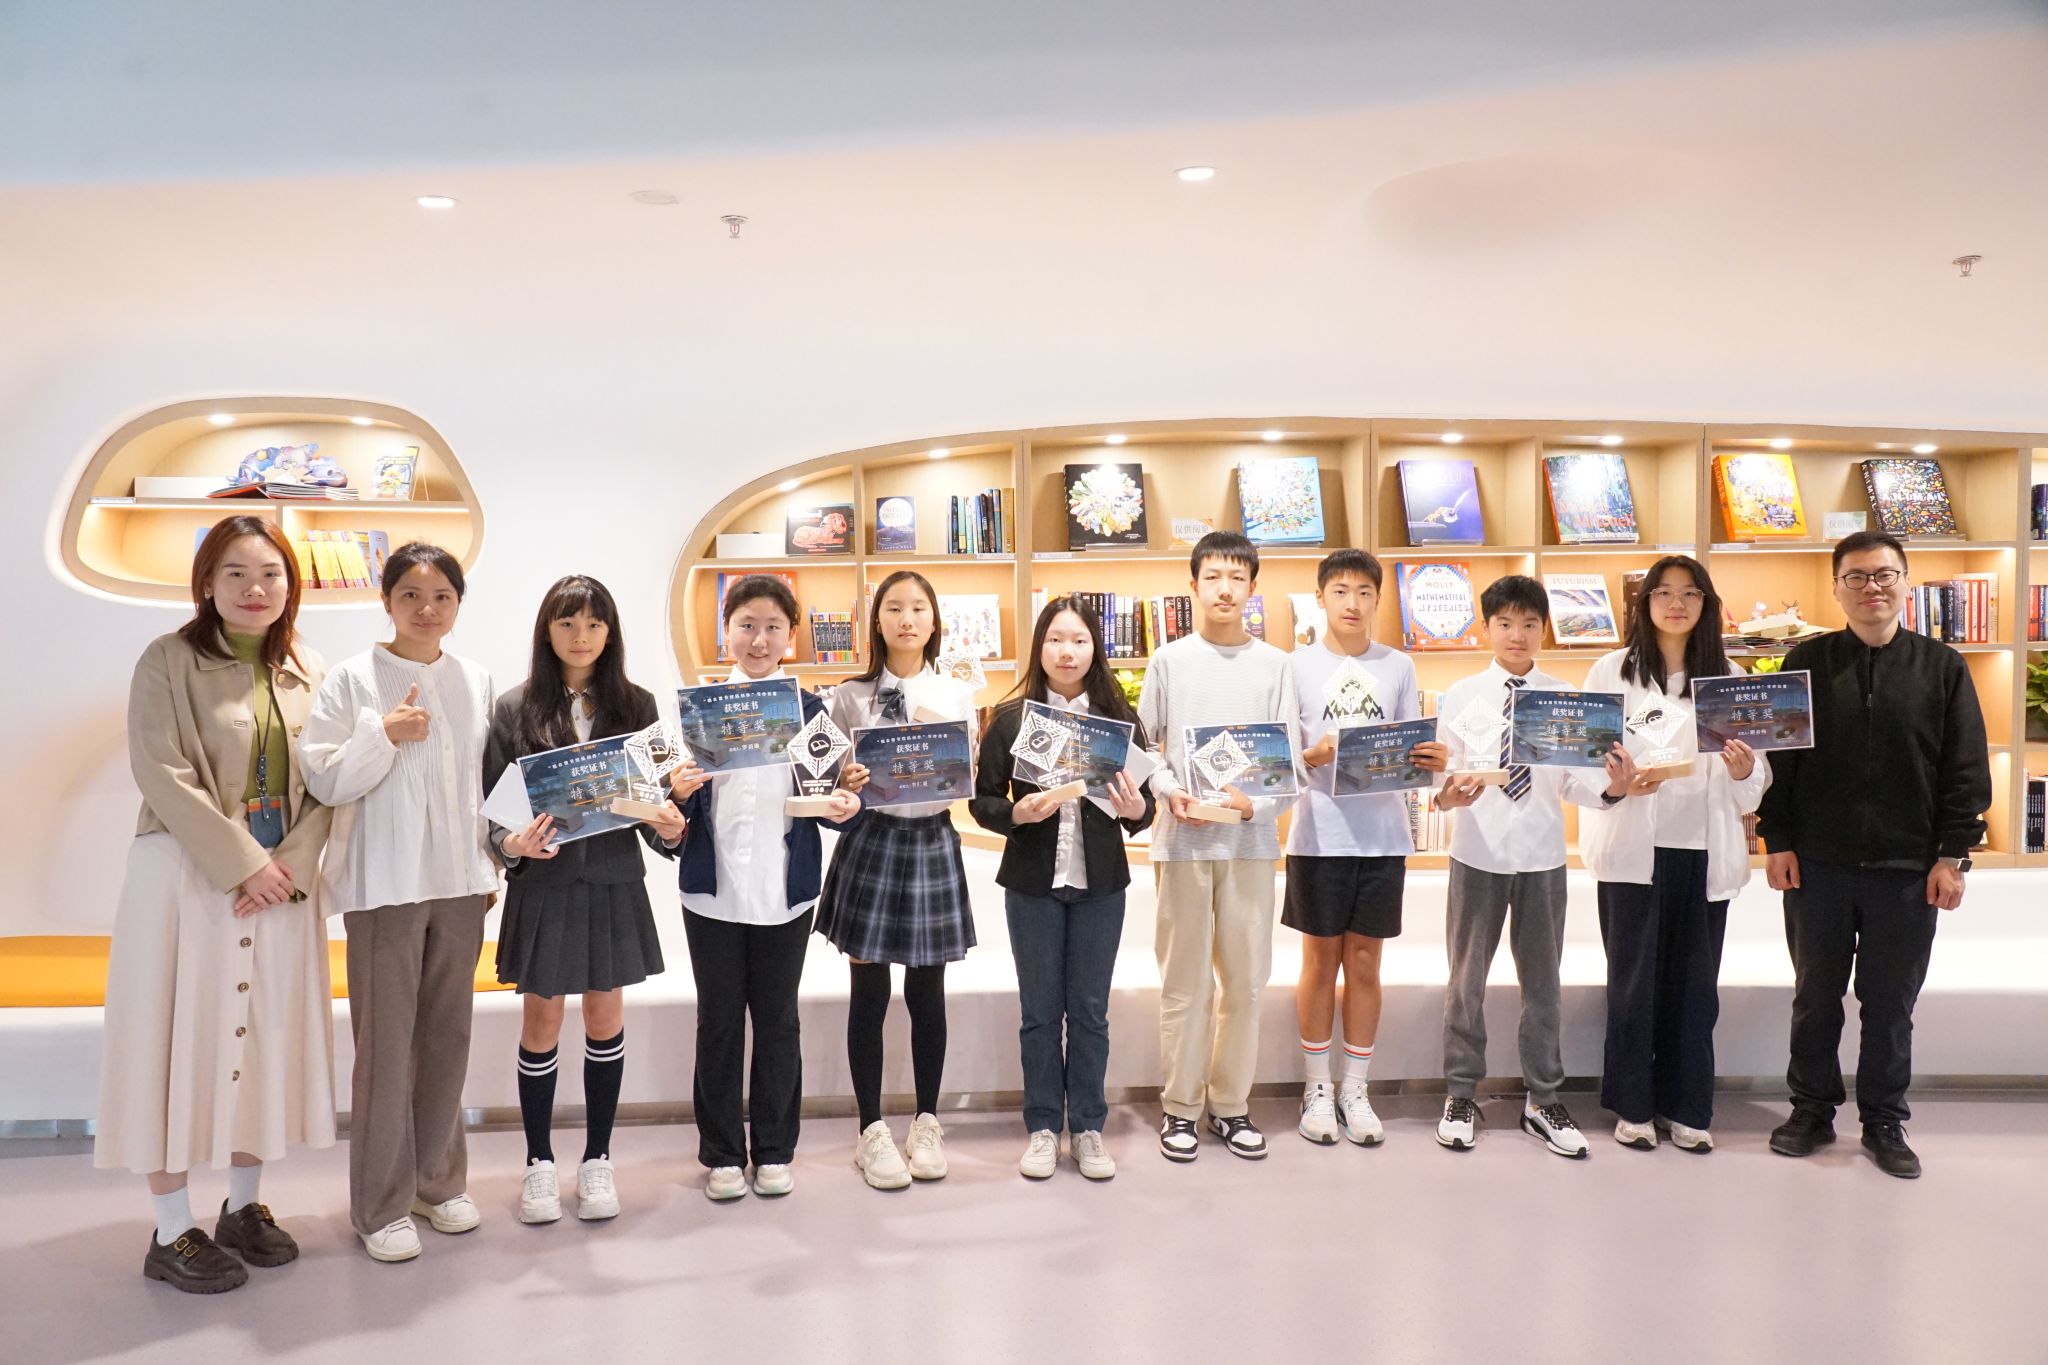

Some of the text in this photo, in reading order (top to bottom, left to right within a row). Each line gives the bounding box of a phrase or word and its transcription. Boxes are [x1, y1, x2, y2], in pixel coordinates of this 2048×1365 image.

[1861, 463, 1876, 511] ANIMAL
[1882, 492, 1945, 501] ANIMAL
[1425, 581, 1454, 589] MOLLY
[1552, 577, 1597, 585] FUTURISM
[1416, 593, 1467, 601] MATHEMATICAL
[1734, 692, 1768, 702] 获奖证书
[723, 700, 760, 713] 获奖证书
[1551, 708, 1584, 717] 获奖证书
[1731, 708, 1774, 721] 特等奖
[720, 719, 766, 736] 特等奖
[1546, 724, 1587, 737] 特等奖
[896, 742, 929, 753] 获奖证书
[1374, 738, 1403, 748] 获奖证书
[892, 759, 935, 773] 特等奖
[1368, 753, 1405, 766] 特等奖
[571, 761, 608, 777] 获奖证书
[570, 781, 618, 800] 特等奖
